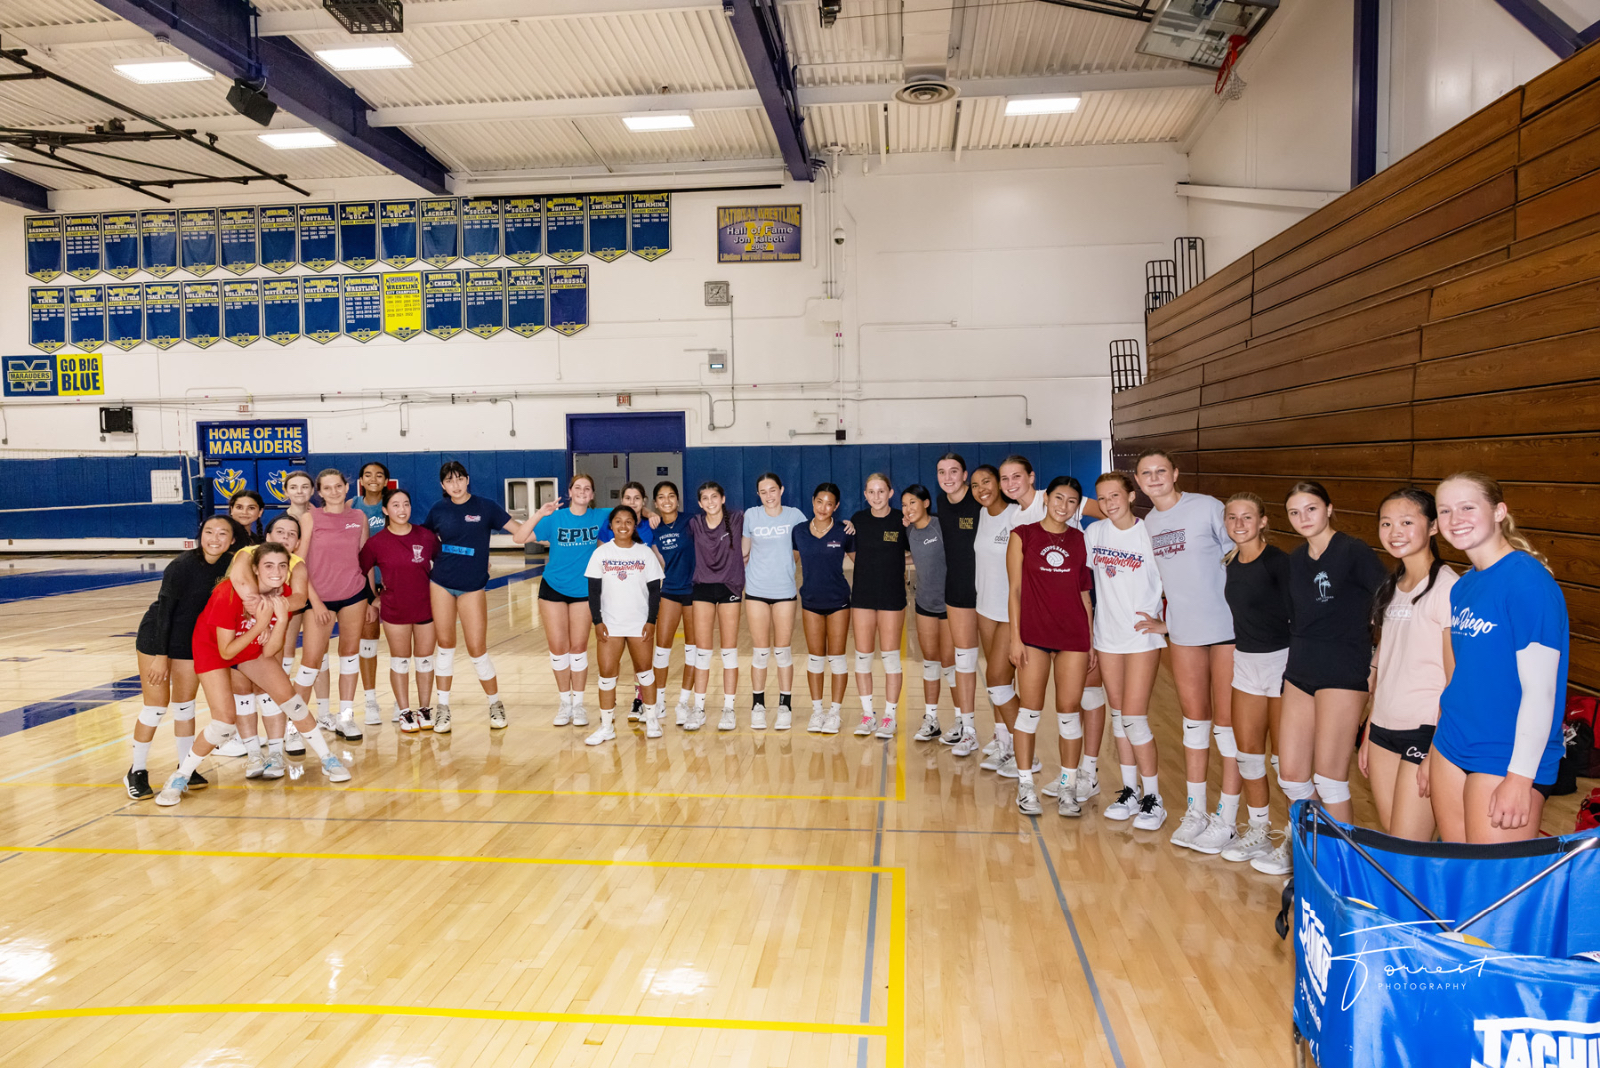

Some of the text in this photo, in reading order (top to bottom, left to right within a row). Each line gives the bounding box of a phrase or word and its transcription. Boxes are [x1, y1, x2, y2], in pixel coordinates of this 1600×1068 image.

[720, 207, 800, 228] NATIONAL WRESTLING
[60, 358, 99, 372] GO BIG
[61, 372, 100, 391] BLUE
[618, 395, 629, 404] EXIT
[209, 427, 302, 439] HOME OF THE
[209, 440, 302, 454] MARAUDERS
[558, 525, 599, 542] EPIC
[753, 525, 790, 536] COAST
[1460, 607, 1498, 637] Diego
[1406, 746, 1428, 759] Coa
